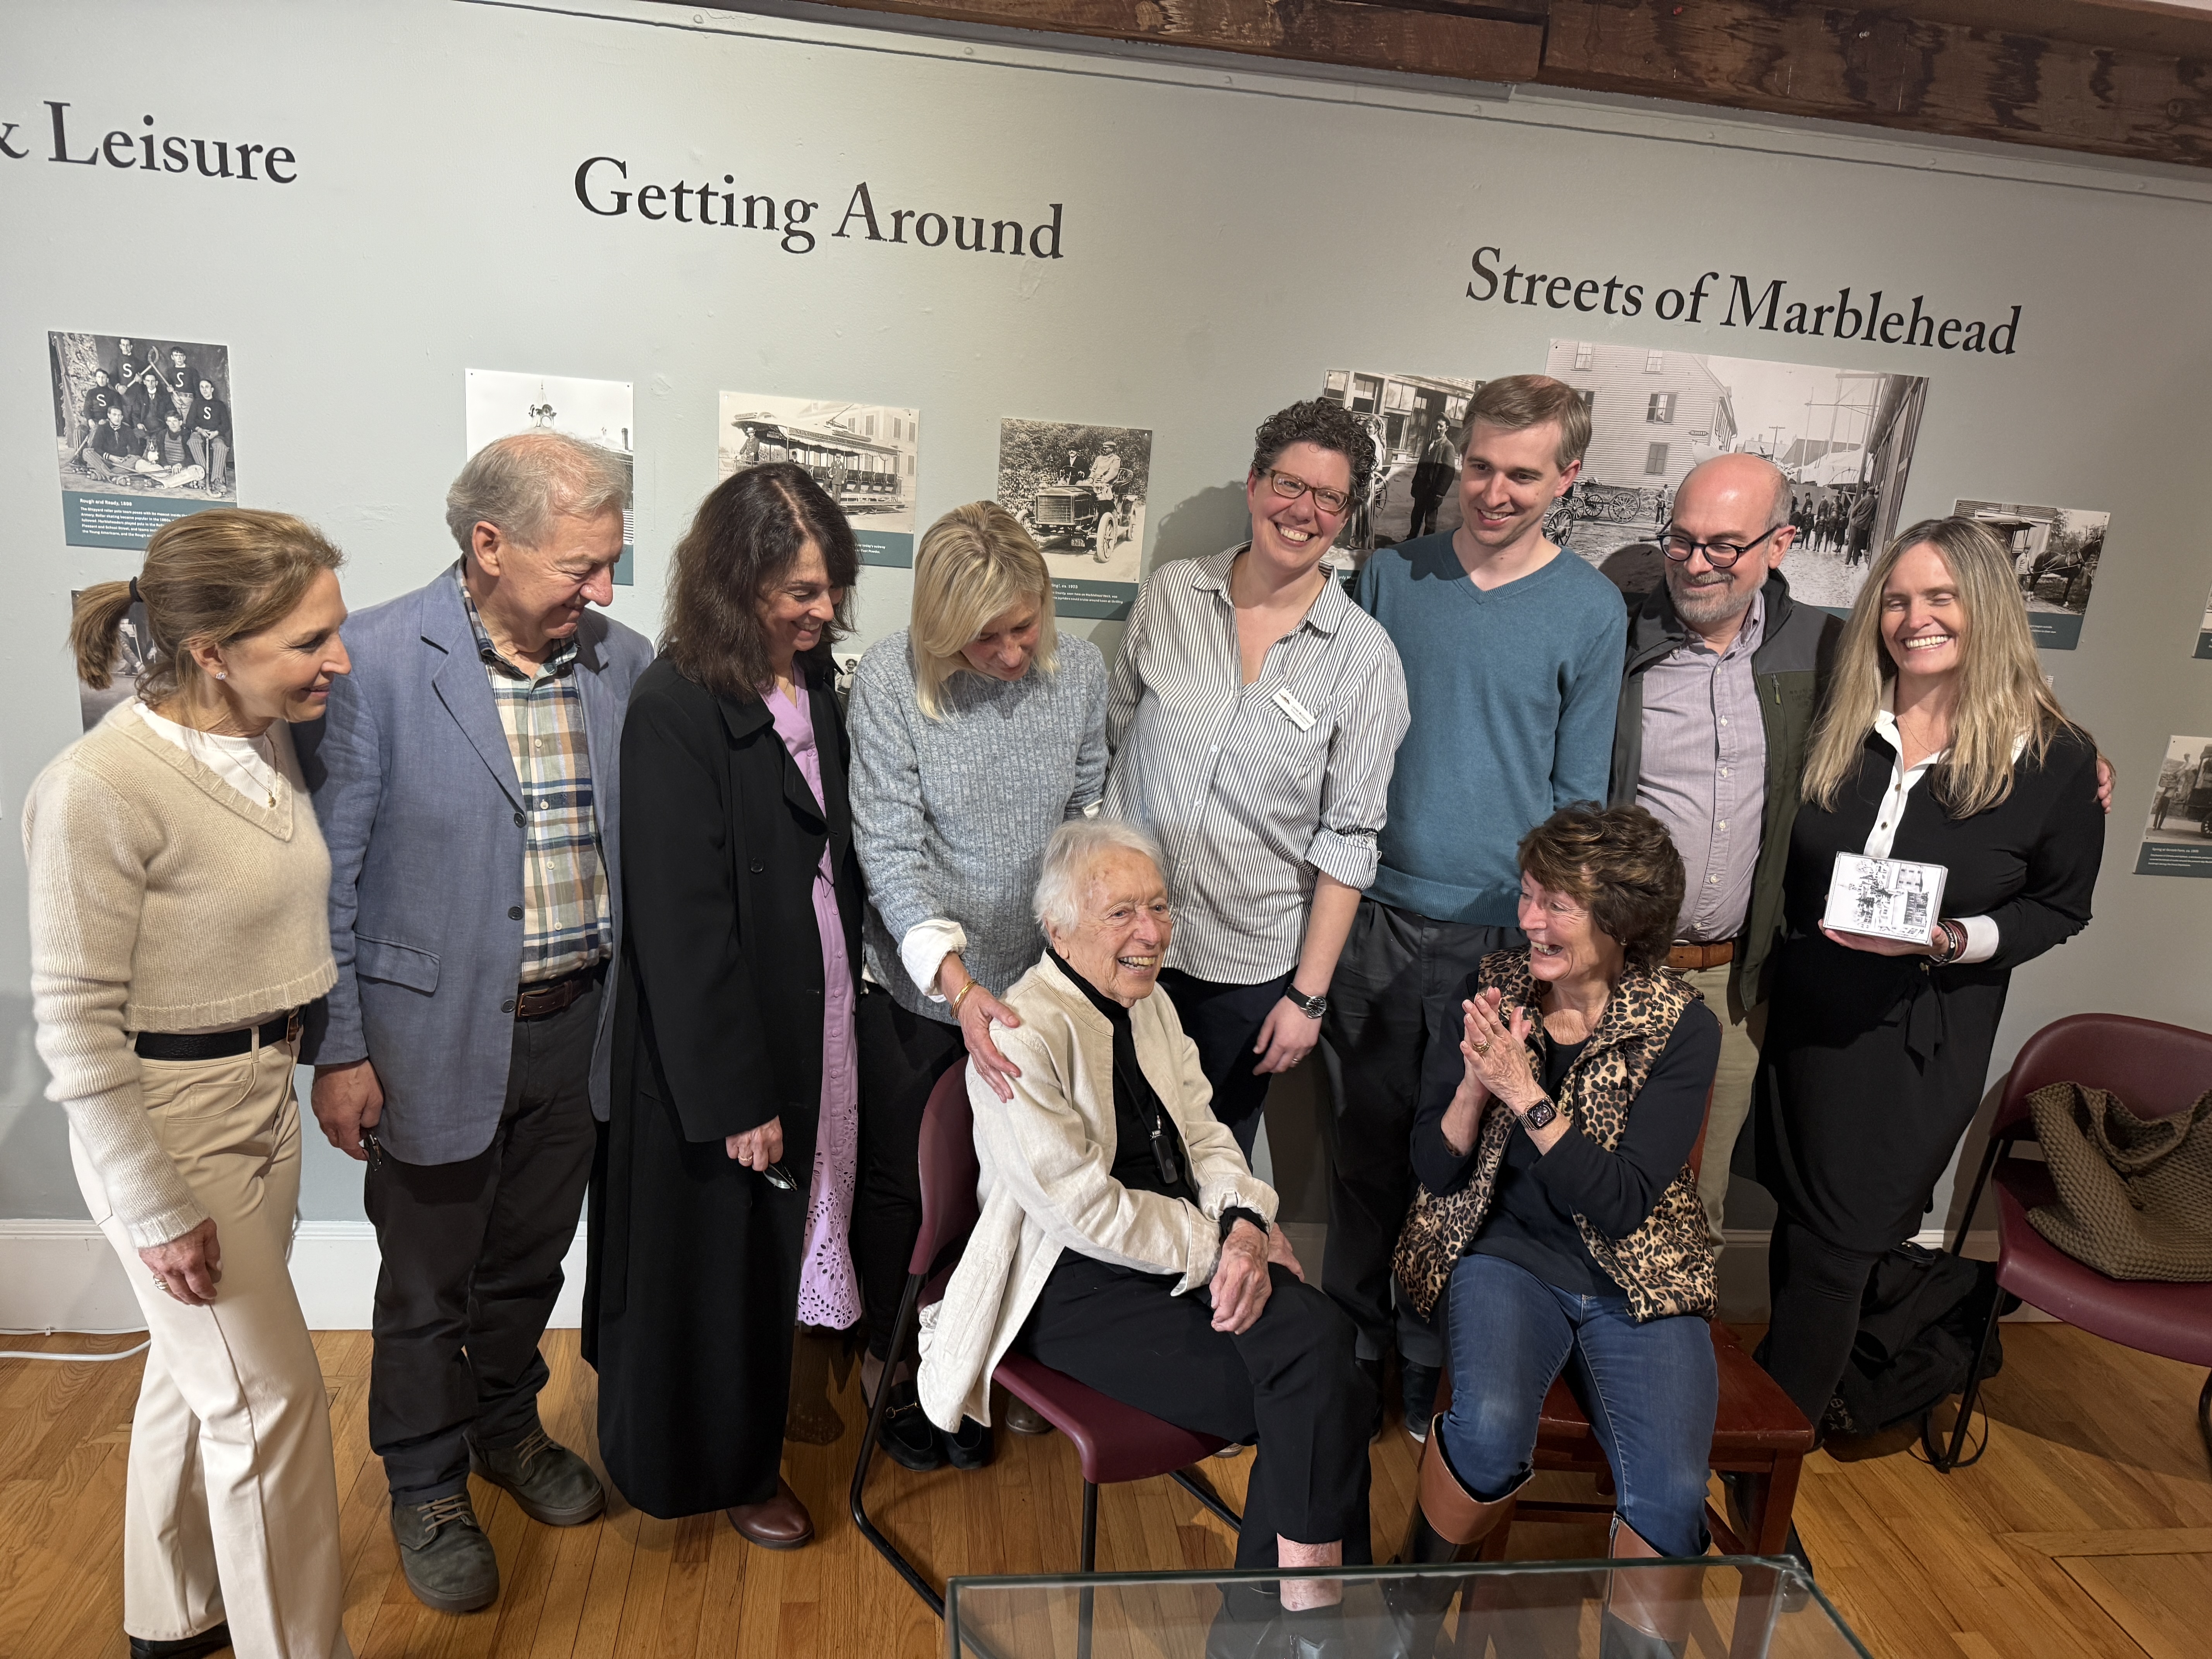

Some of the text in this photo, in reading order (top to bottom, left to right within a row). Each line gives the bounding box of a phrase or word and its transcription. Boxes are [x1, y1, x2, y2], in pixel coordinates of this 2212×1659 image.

[44, 101, 297, 183] Leisure
[575, 157, 1063, 259] Getting Around
[1466, 247, 2022, 355] Streets of Marblehead
[122, 363, 132, 378] S
[175, 372, 184, 388] S
[96, 393, 106, 407] S
[203, 406, 211, 420] S
